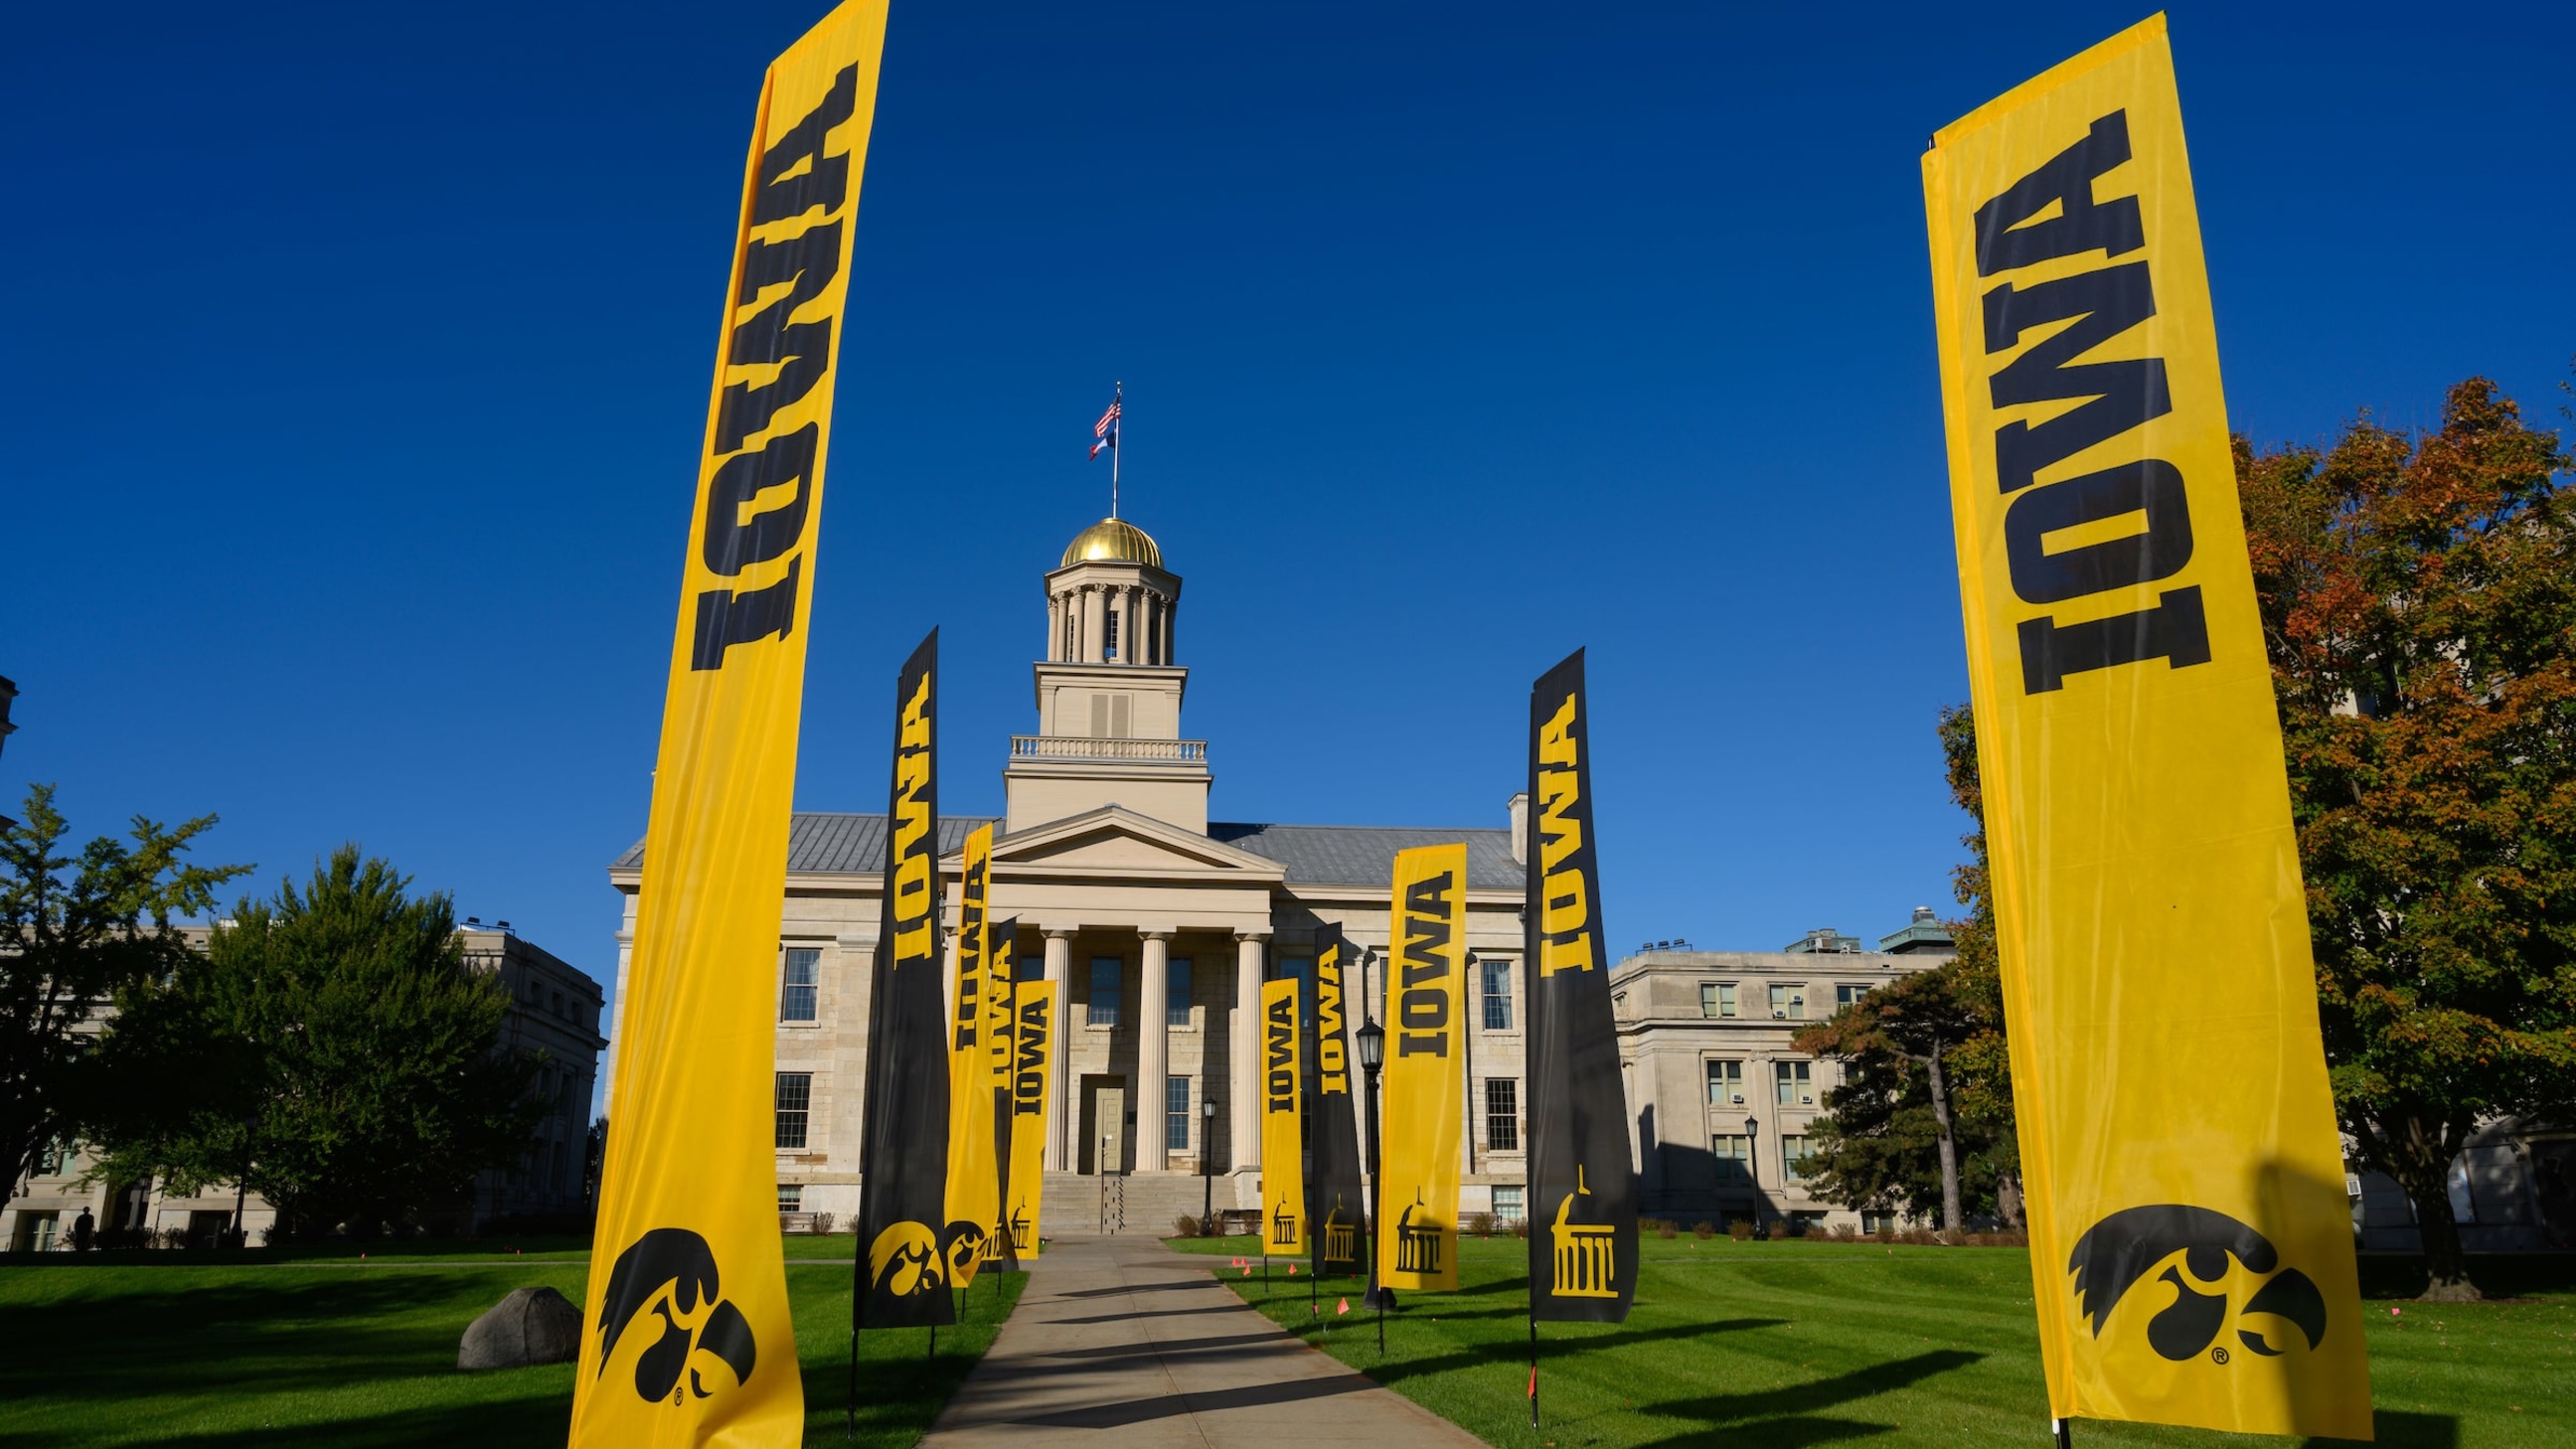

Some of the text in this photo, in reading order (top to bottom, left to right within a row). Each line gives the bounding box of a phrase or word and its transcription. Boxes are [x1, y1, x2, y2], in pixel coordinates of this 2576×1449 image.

[692, 60, 859, 672] IOWA
[1974, 107, 2212, 696] IOWA
[893, 671, 932, 970] IOWA
[1538, 692, 1594, 978] IOWA
[955, 853, 986, 1052] IOWA
[1317, 943, 1348, 1096] IOWA
[1399, 871, 1453, 1058] IOWA
[1014, 997, 1047, 1116] IOWA
[1269, 996, 1294, 1114] IOWA
